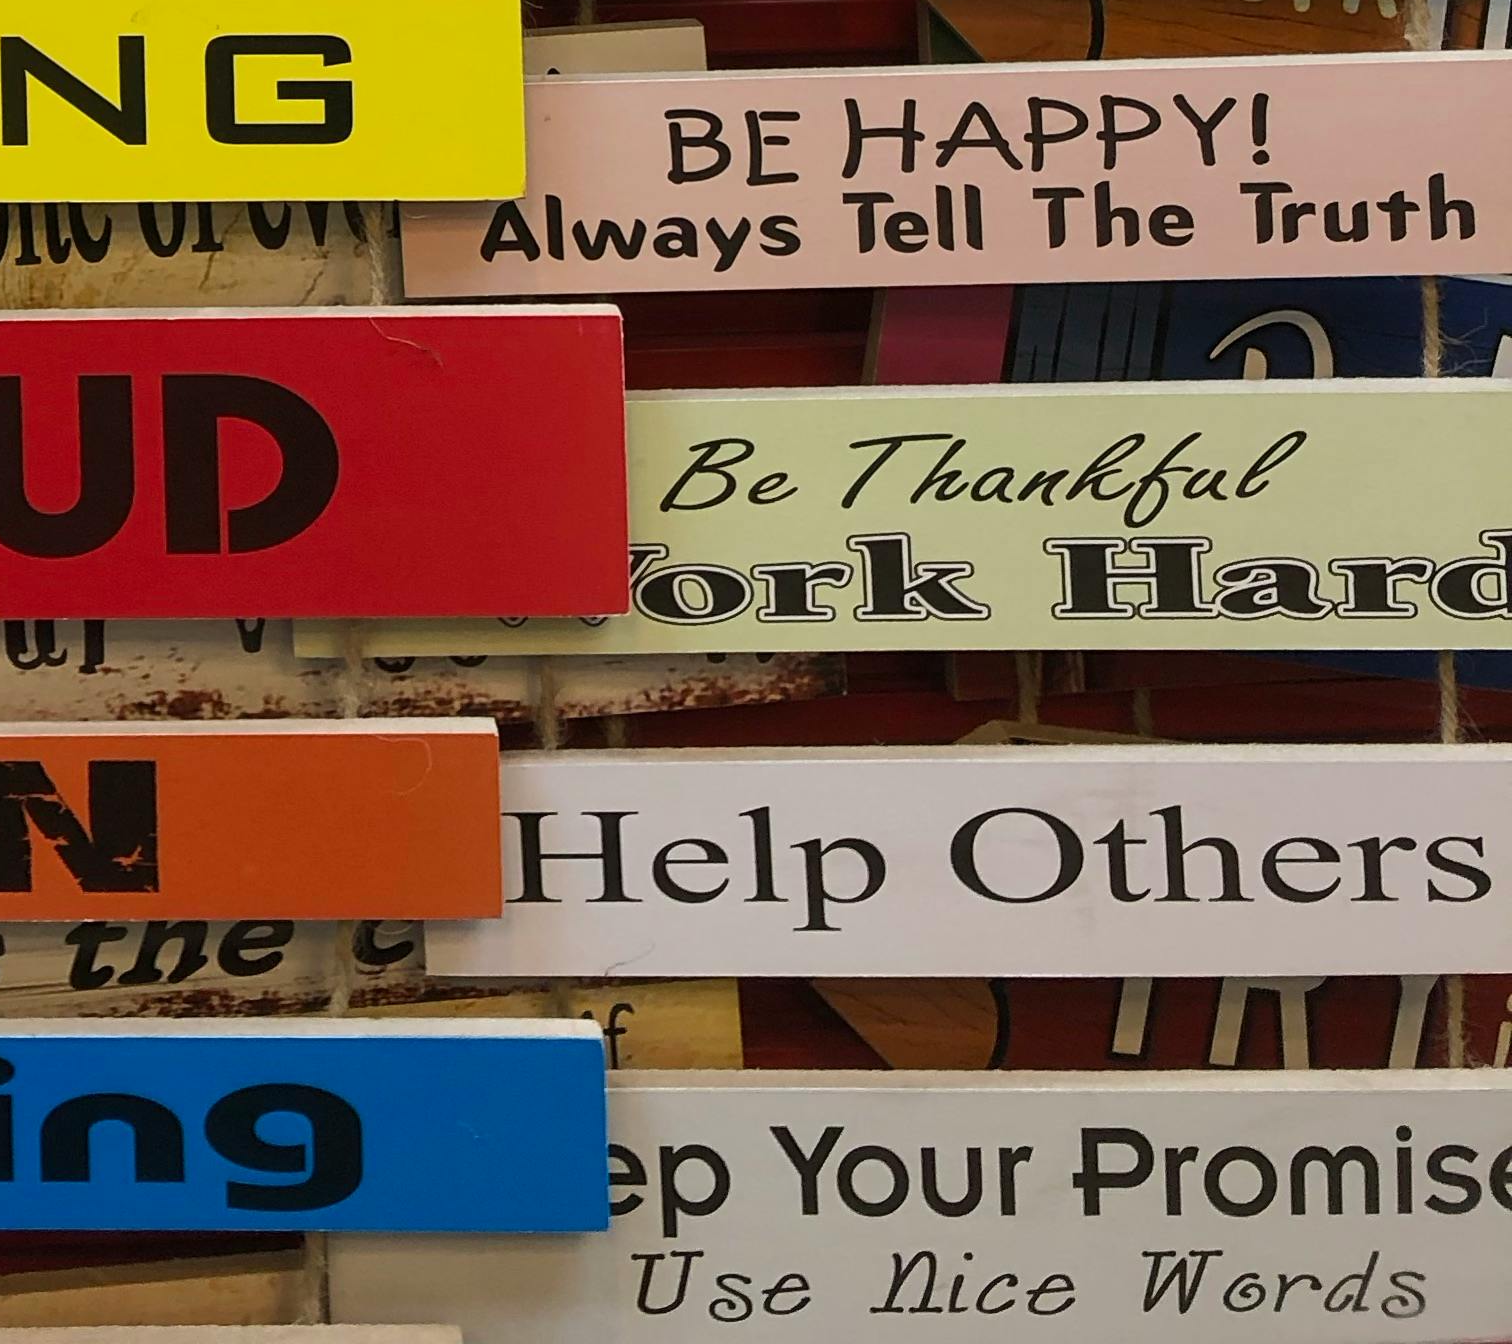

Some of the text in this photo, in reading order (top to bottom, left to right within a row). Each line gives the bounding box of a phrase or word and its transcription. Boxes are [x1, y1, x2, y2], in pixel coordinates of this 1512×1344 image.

[664, 93, 1269, 186] BE HAPPY!
[480, 193, 802, 272] Always
[843, 183, 983, 254] Tell
[1033, 181, 1195, 249] The
[1240, 173, 1477, 245] Truth
[660, 431, 1307, 528] Be Thankful
[1043, 529, 1512, 621] Hard
[502, 805, 1491, 931] Help Others
[769, 1126, 1033, 1217] Your
[631, 1250, 1426, 1322] Use Nice Words
